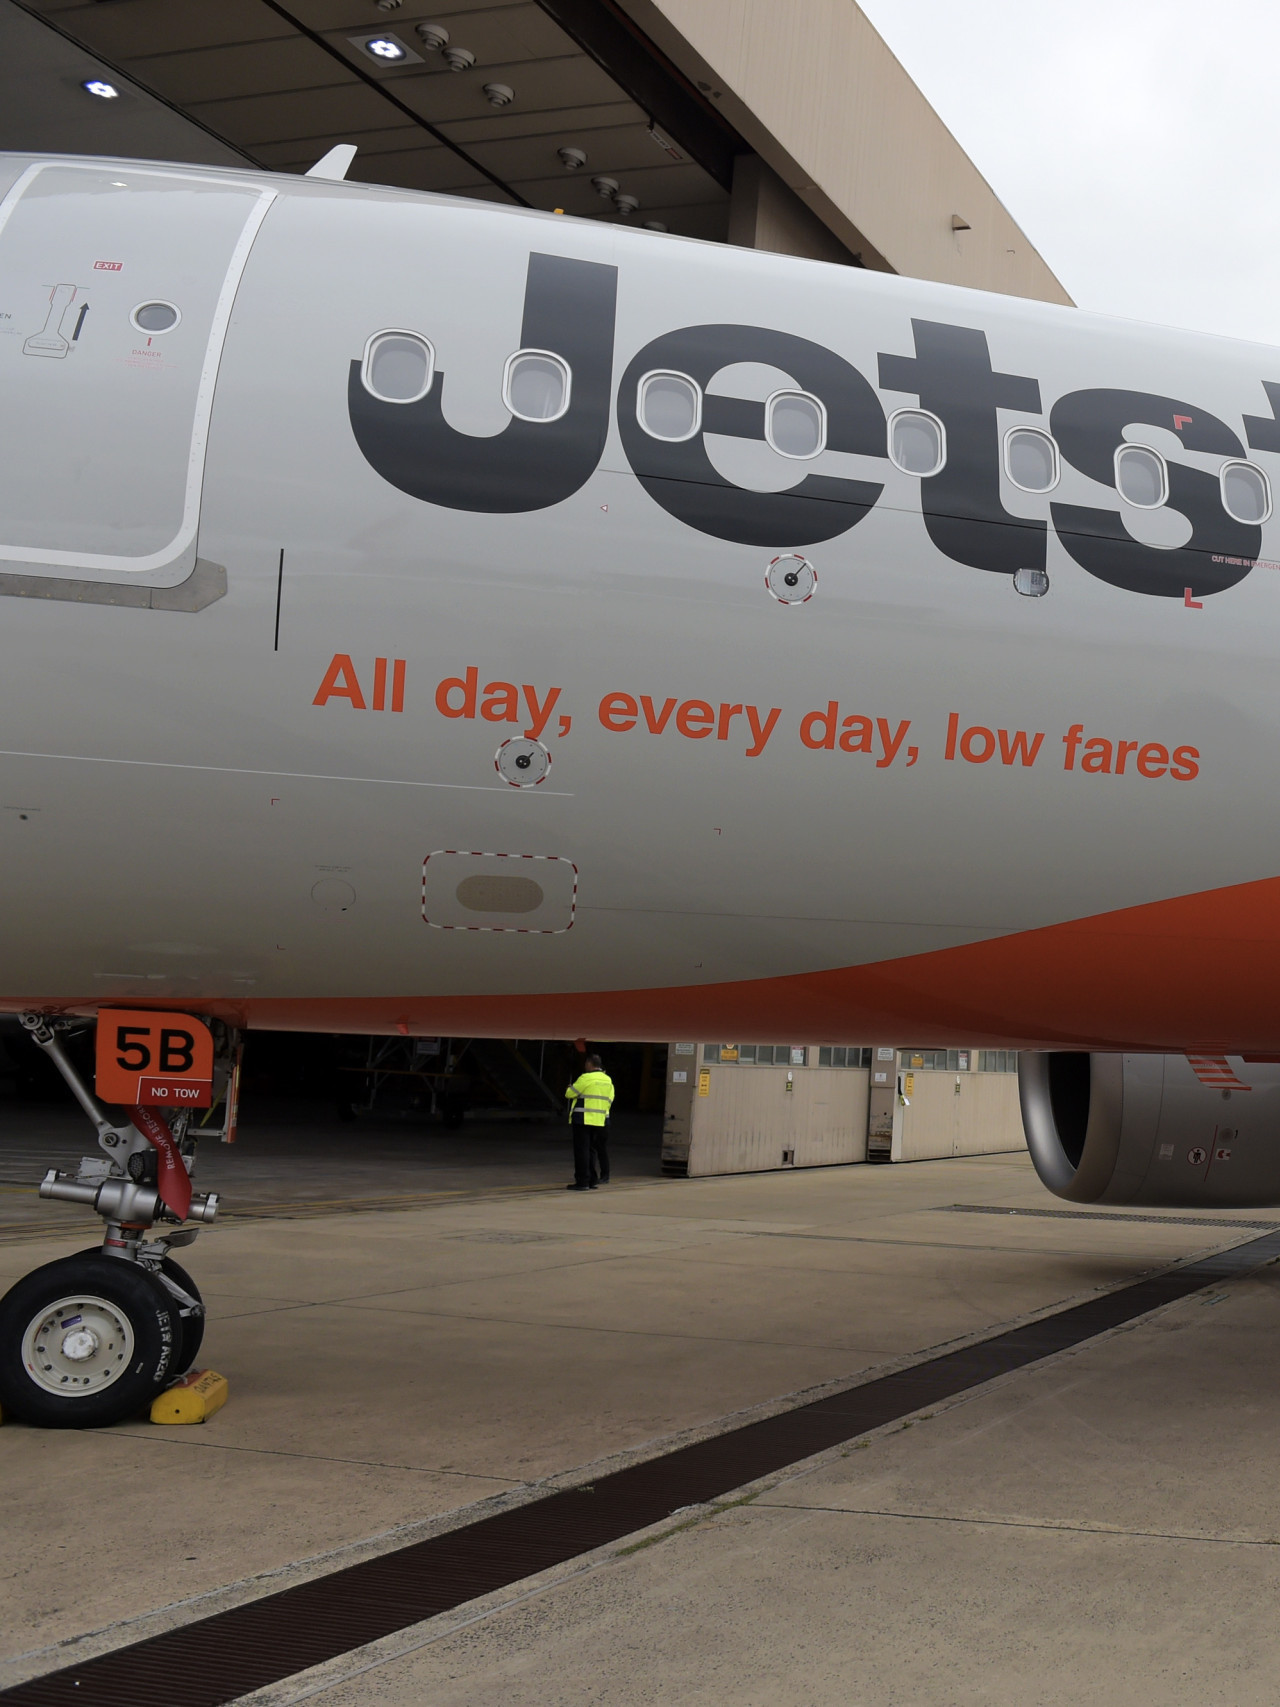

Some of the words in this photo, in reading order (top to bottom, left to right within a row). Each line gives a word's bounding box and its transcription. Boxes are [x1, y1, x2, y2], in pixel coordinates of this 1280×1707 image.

[95, 262, 121, 270] EXIT
[131, 349, 162, 358] DANGER
[1211, 555, 1224, 563] CUT
[1225, 557, 1242, 566] HERE
[312, 653, 406, 712] All
[434, 666, 572, 738] day,
[598, 691, 782, 757] every
[799, 700, 919, 768] day,
[944, 712, 1045, 767] low
[1062, 724, 1200, 781] fares
[116, 1026, 194, 1072] 5B
[151, 1087, 168, 1097] NO
[173, 1088, 200, 1098] TOW
[155, 1132, 176, 1170] REMOVE
